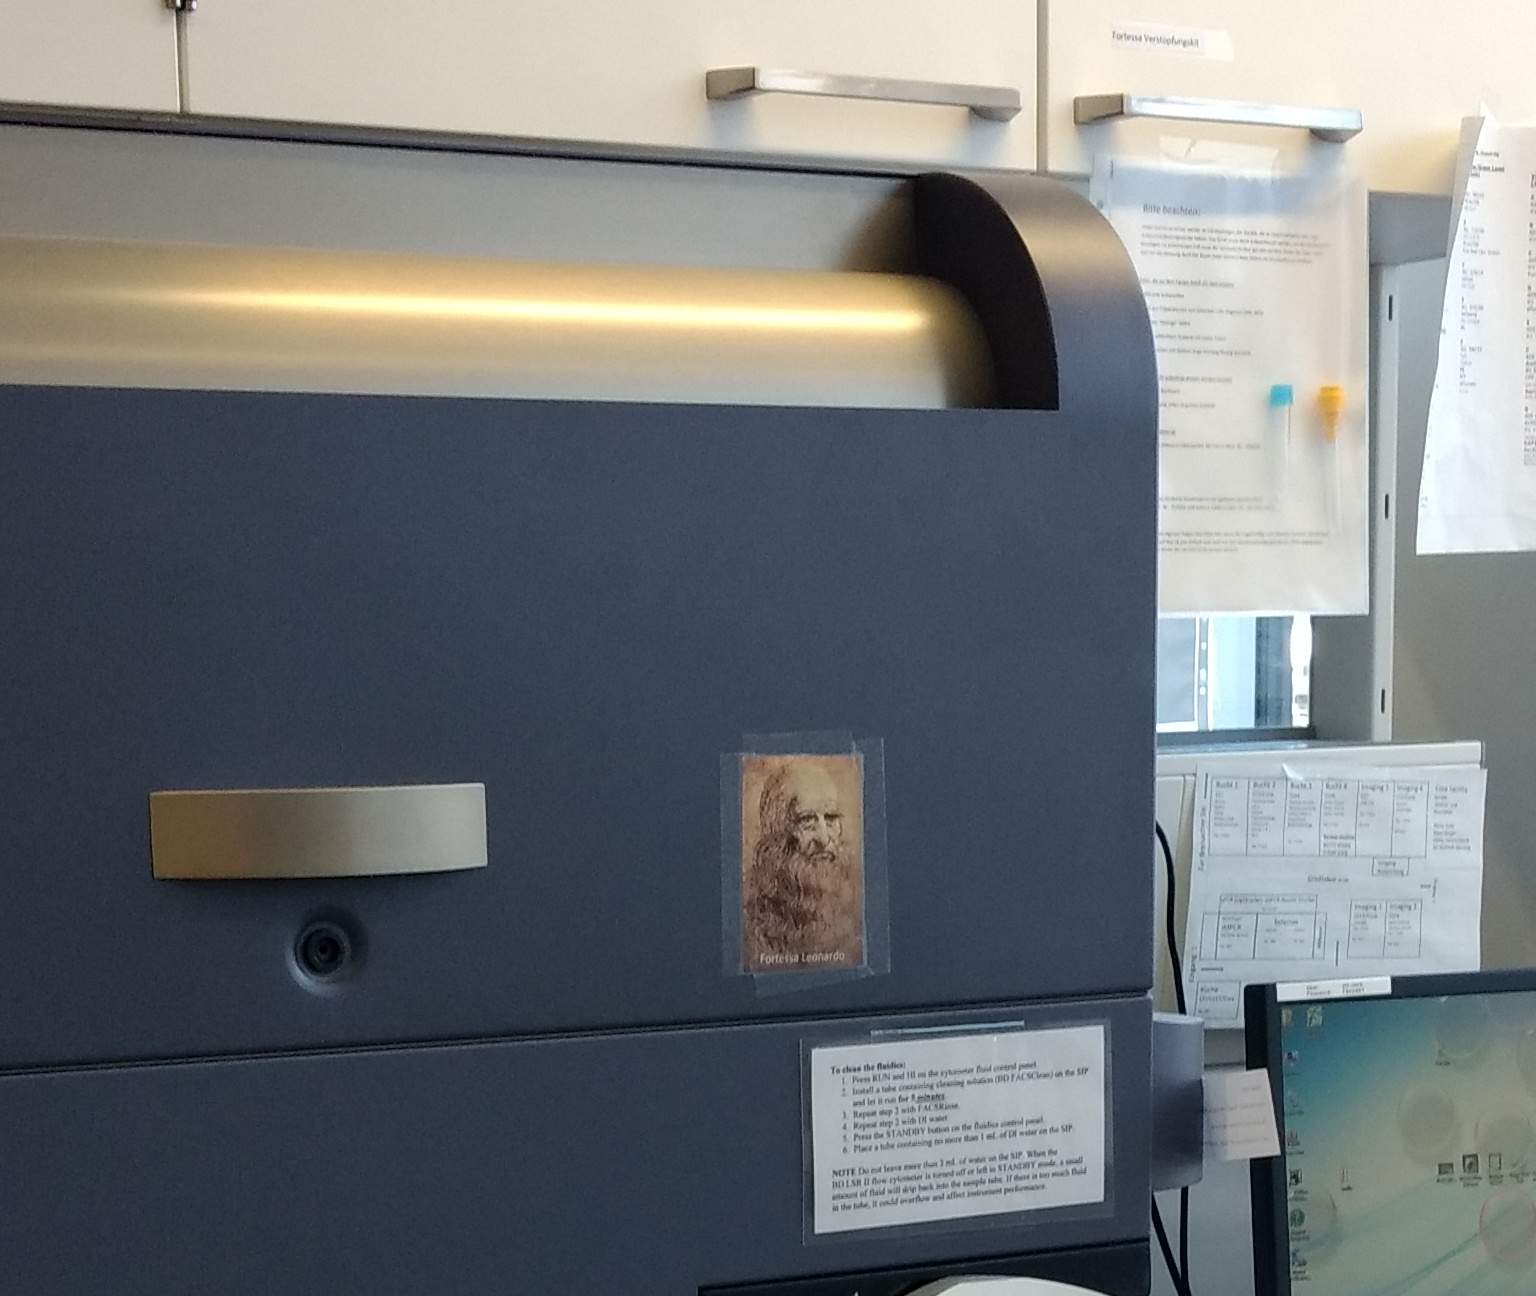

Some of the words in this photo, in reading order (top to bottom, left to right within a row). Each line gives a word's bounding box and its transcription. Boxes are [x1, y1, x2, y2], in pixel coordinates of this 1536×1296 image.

[832, 1066, 840, 1074] To
[842, 1064, 862, 1074] clean
[864, 1064, 874, 1072] the
[892, 1072, 905, 1080] and
[928, 1069, 939, 1077] the
[852, 1099, 866, 1107] and
[898, 1094, 909, 1103] for
[901, 1105, 916, 1114] with
[901, 1117, 916, 1125] with
[853, 1133, 872, 1142] Press
[874, 1132, 884, 1140] the
[880, 1142, 895, 1150] tube
[1049, 1126, 1059, 1134] the
[858, 1167, 870, 1175] Do
[871, 1166, 882, 1174] not
[998, 1152, 1008, 1160] the
[1048, 1148, 1058, 1156] the
[841, 1202, 852, 1212] the
